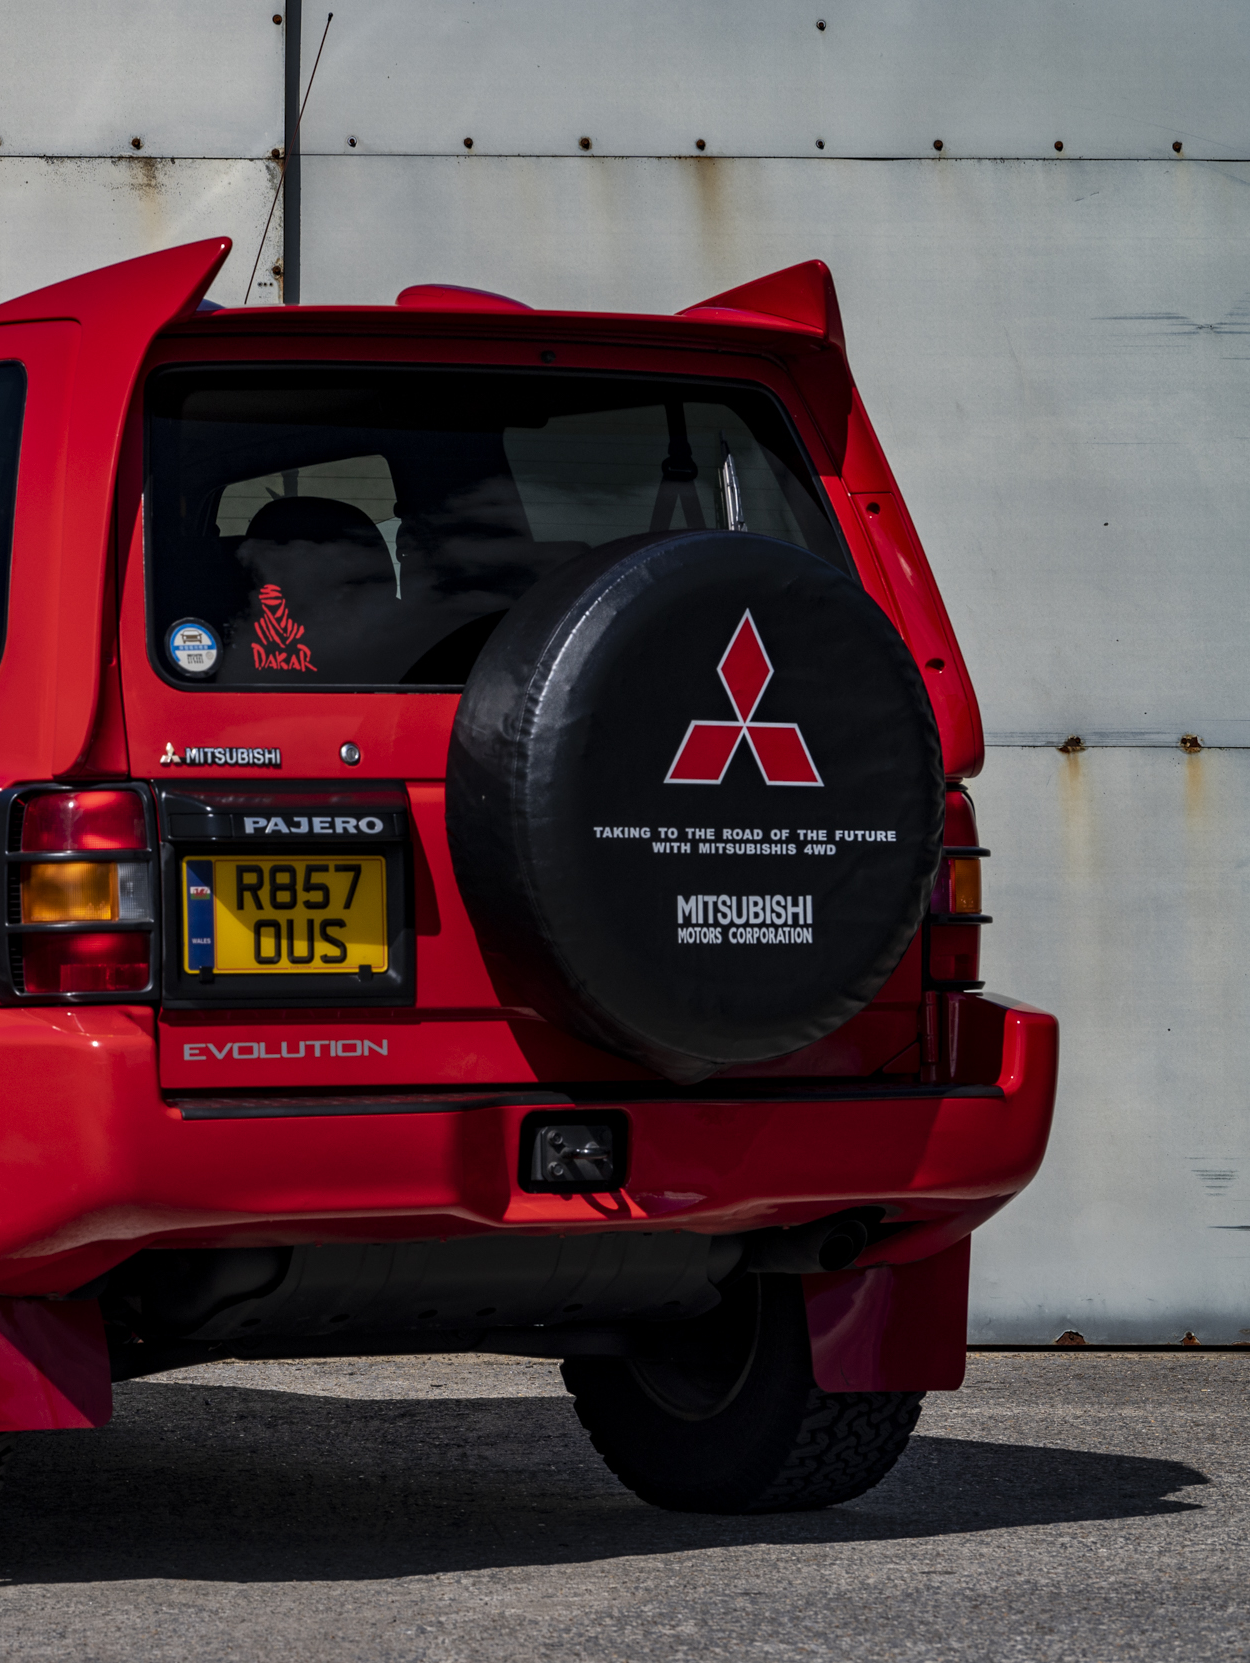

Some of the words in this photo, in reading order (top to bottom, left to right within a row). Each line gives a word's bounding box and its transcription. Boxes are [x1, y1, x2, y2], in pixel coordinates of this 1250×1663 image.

[251, 642, 318, 672] DAKAR
[185, 747, 282, 766] MITSUBISHI
[243, 816, 384, 834] PAJERO
[593, 826, 651, 839] TAKING
[658, 827, 678, 839] TO
[685, 827, 715, 840] THE
[722, 828, 763, 841] ROAD
[770, 829, 790, 841] OF
[797, 829, 827, 841] THE
[835, 829, 897, 842] FUTURE
[652, 842, 691, 854] WITH
[698, 842, 797, 855] MITSUBISHIS
[804, 843, 837, 856] 4WD
[235, 863, 362, 911] R857
[676, 894, 813, 925] MITSUBISHI
[191, 937, 212, 945] WALES
[253, 918, 348, 965] OUS
[678, 927, 722, 944] MOTORS
[728, 927, 813, 944] CORPORATION
[183, 1039, 389, 1061] EVOLUTION
